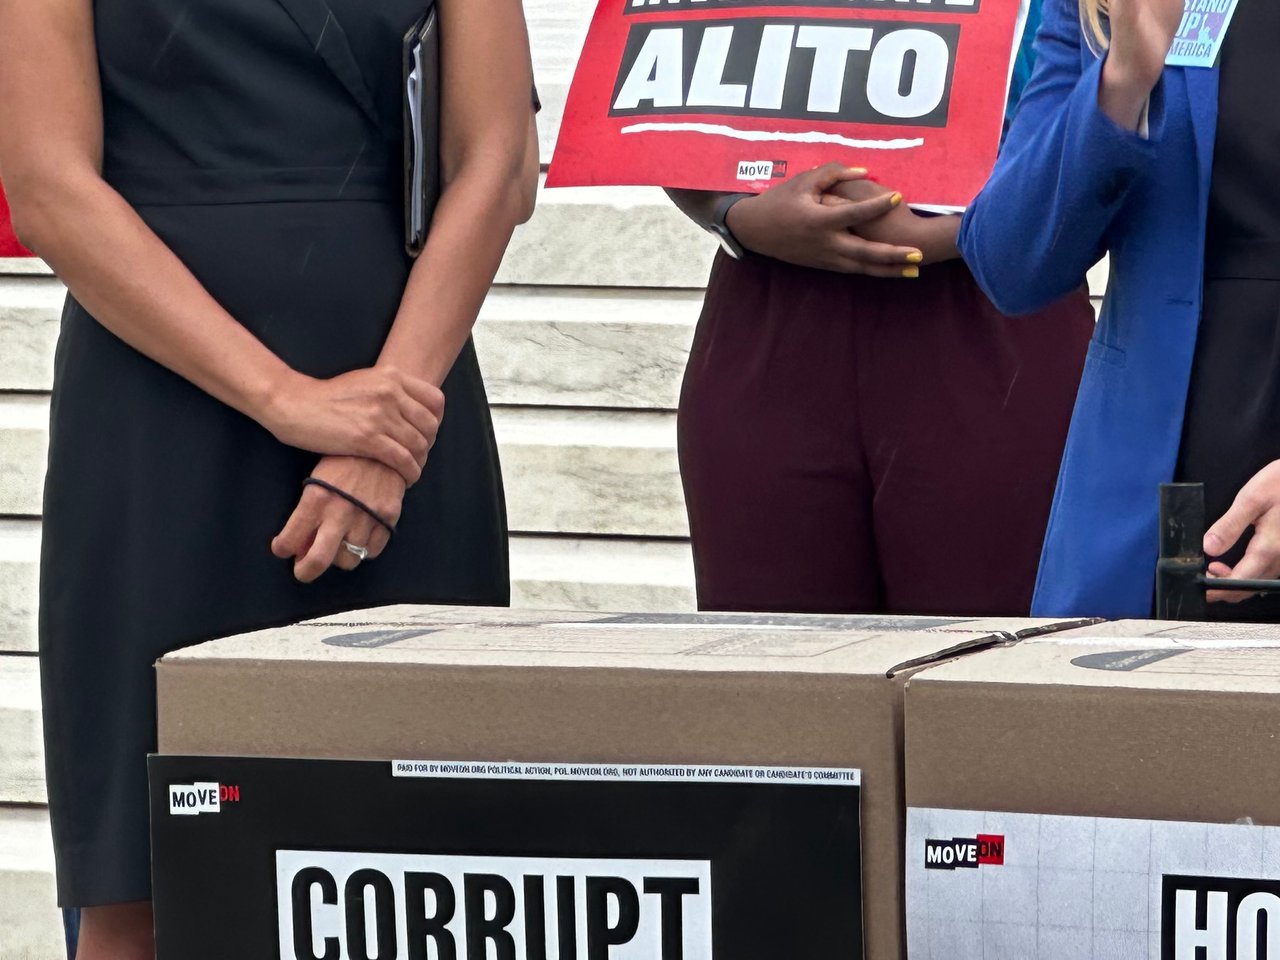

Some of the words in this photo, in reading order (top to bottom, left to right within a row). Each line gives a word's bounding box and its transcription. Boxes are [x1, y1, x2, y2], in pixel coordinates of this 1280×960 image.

[612, 23, 950, 119] ALITO
[1170, 41, 1212, 58] MERICA
[397, 763, 413, 772] PAID
[414, 763, 428, 773] FOR
[429, 764, 439, 773] BY
[622, 767, 637, 777] NOT
[639, 767, 685, 777] AUTHORIZED
[686, 768, 696, 777] BY
[755, 769, 765, 778] OR
[291, 866, 700, 960] CORRUPT
